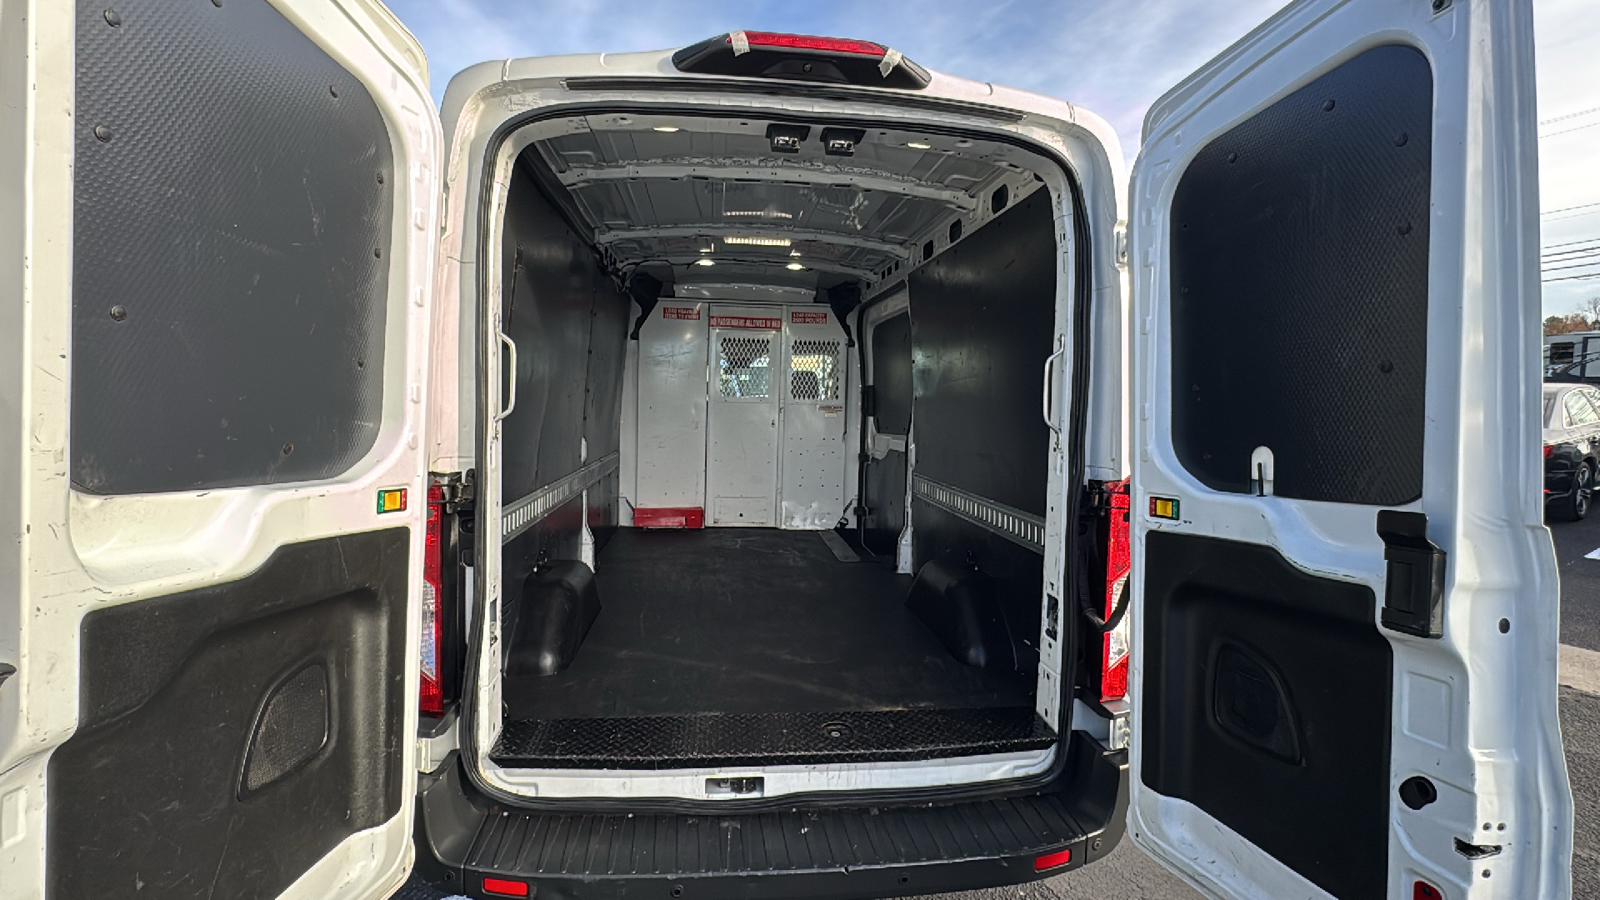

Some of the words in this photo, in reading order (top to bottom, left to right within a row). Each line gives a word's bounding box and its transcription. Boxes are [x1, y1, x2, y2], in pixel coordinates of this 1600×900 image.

[710, 318, 717, 326] NO
[718, 318, 745, 327] PASSENGERS
[746, 319, 765, 328] ALLOWED
[766, 320, 771, 328] IN
